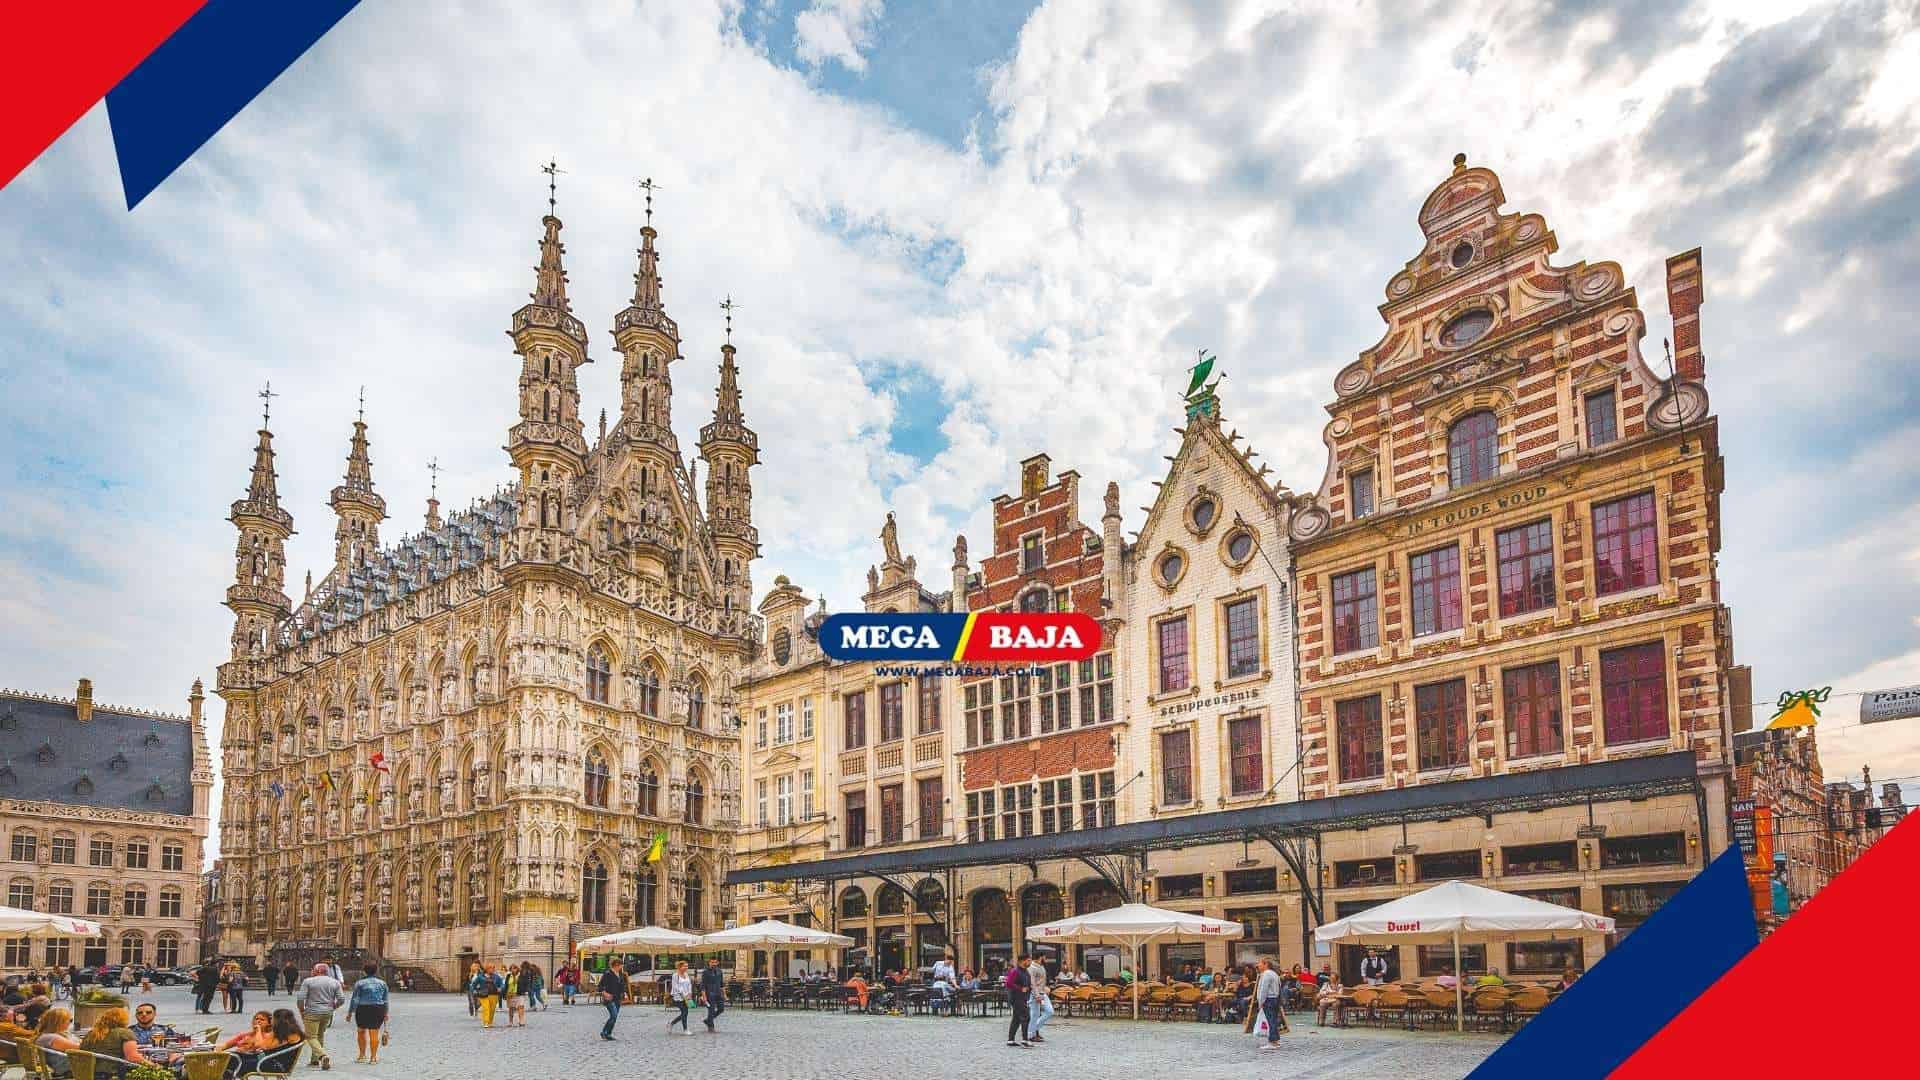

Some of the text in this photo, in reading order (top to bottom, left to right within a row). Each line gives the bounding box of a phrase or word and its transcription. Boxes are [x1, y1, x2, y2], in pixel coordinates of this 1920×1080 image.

[1408, 521, 1424, 536] IN
[1445, 502, 1491, 523] OUDE
[1497, 486, 1547, 508] WOUD
[1387, 920, 1421, 932] Duvel
